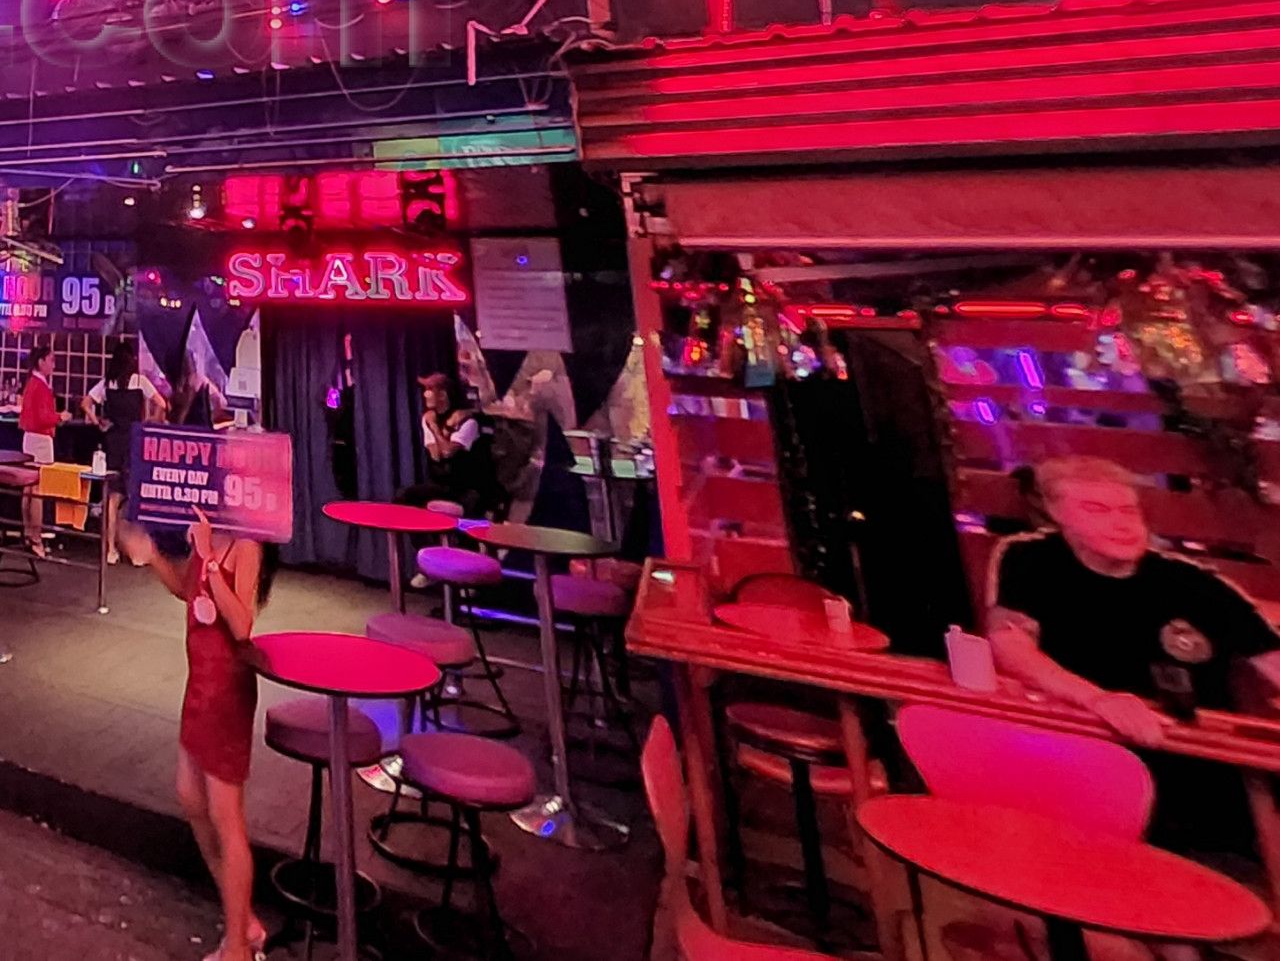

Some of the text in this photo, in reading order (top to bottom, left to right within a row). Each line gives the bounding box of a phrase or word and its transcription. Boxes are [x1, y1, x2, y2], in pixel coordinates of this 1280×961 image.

[228, 252, 467, 302] SHARK
[61, 276, 101, 316] 95
[143, 437, 212, 466] HAPPY
[152, 466, 209, 486] EVERY DAY
[223, 473, 263, 511] 95
[200, 489, 219, 506] PM
